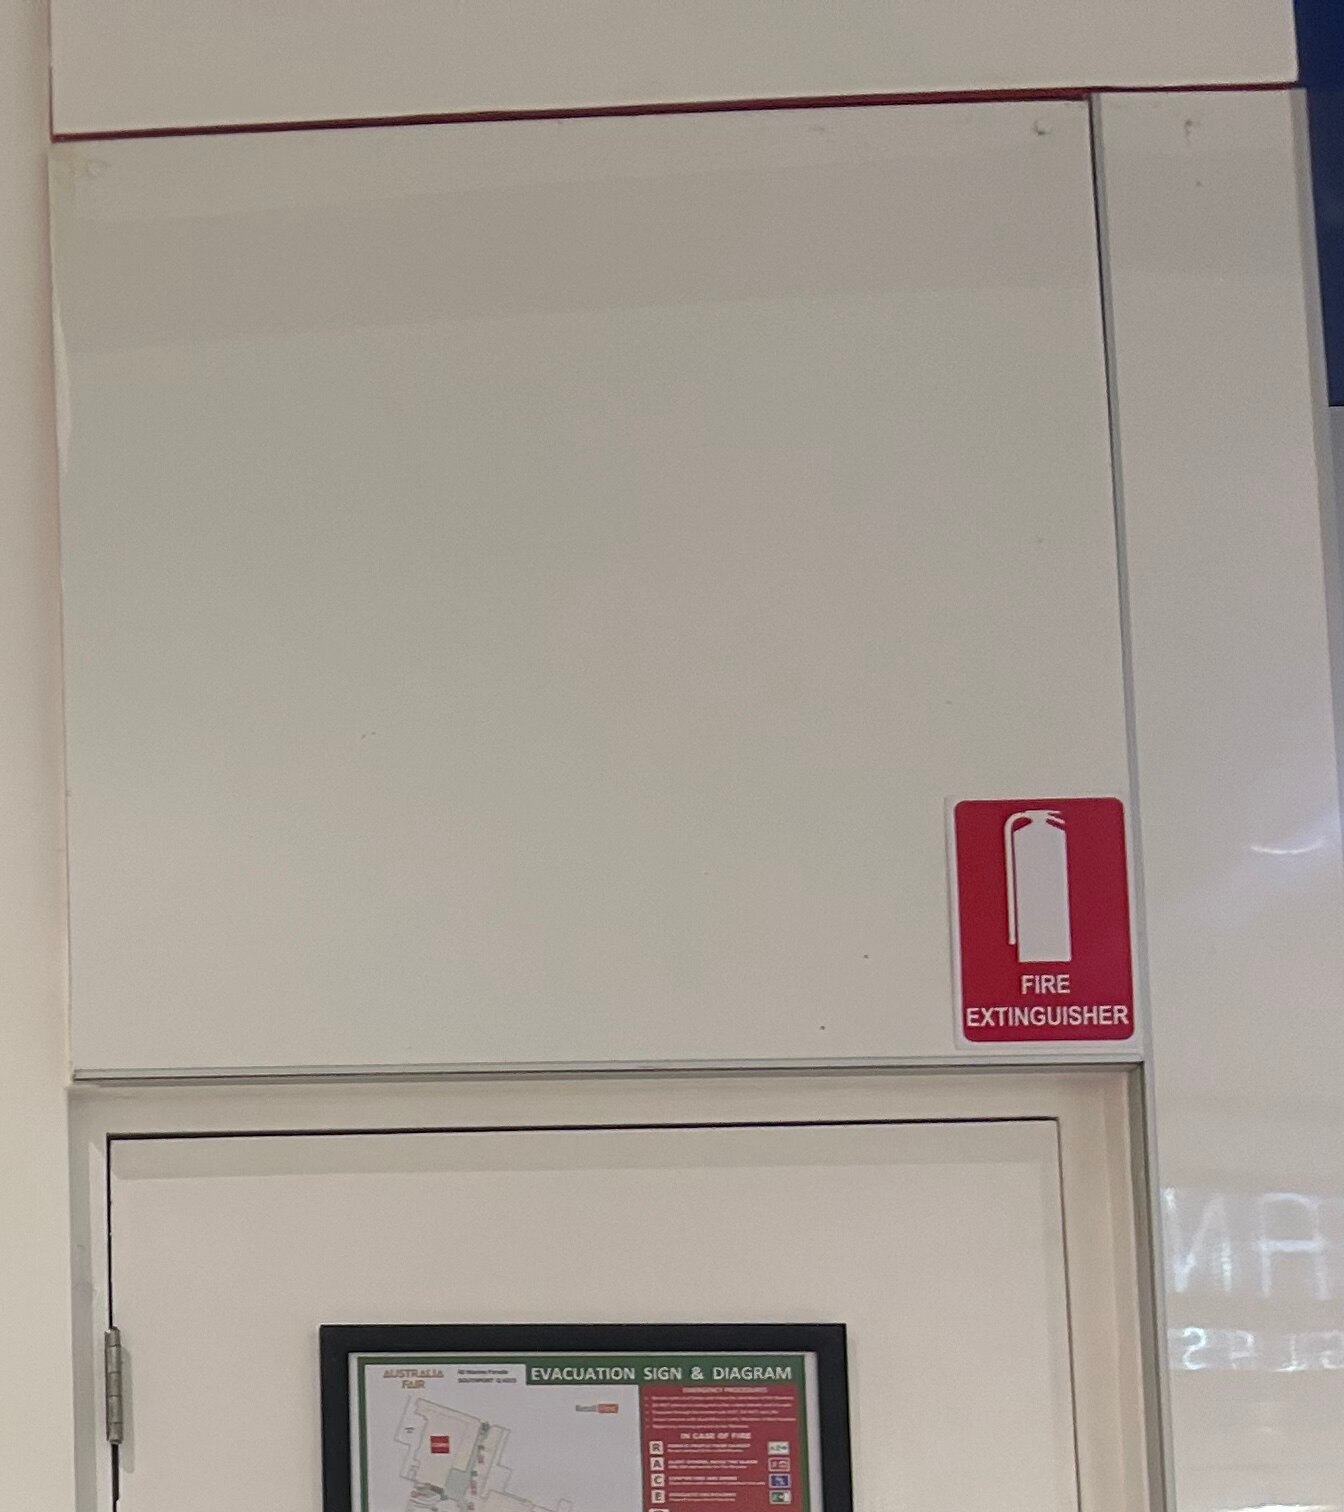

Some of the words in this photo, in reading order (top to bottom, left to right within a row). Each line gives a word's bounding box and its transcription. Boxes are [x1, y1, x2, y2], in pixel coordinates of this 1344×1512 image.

[1020, 973, 1072, 996] FIRE
[965, 1004, 1131, 1028] EXTINGUISHER
[531, 1366, 636, 1381] EVACUATION
[643, 1366, 683, 1381] SIGN
[690, 1365, 705, 1381] &
[712, 1366, 793, 1381] DIAGRAM
